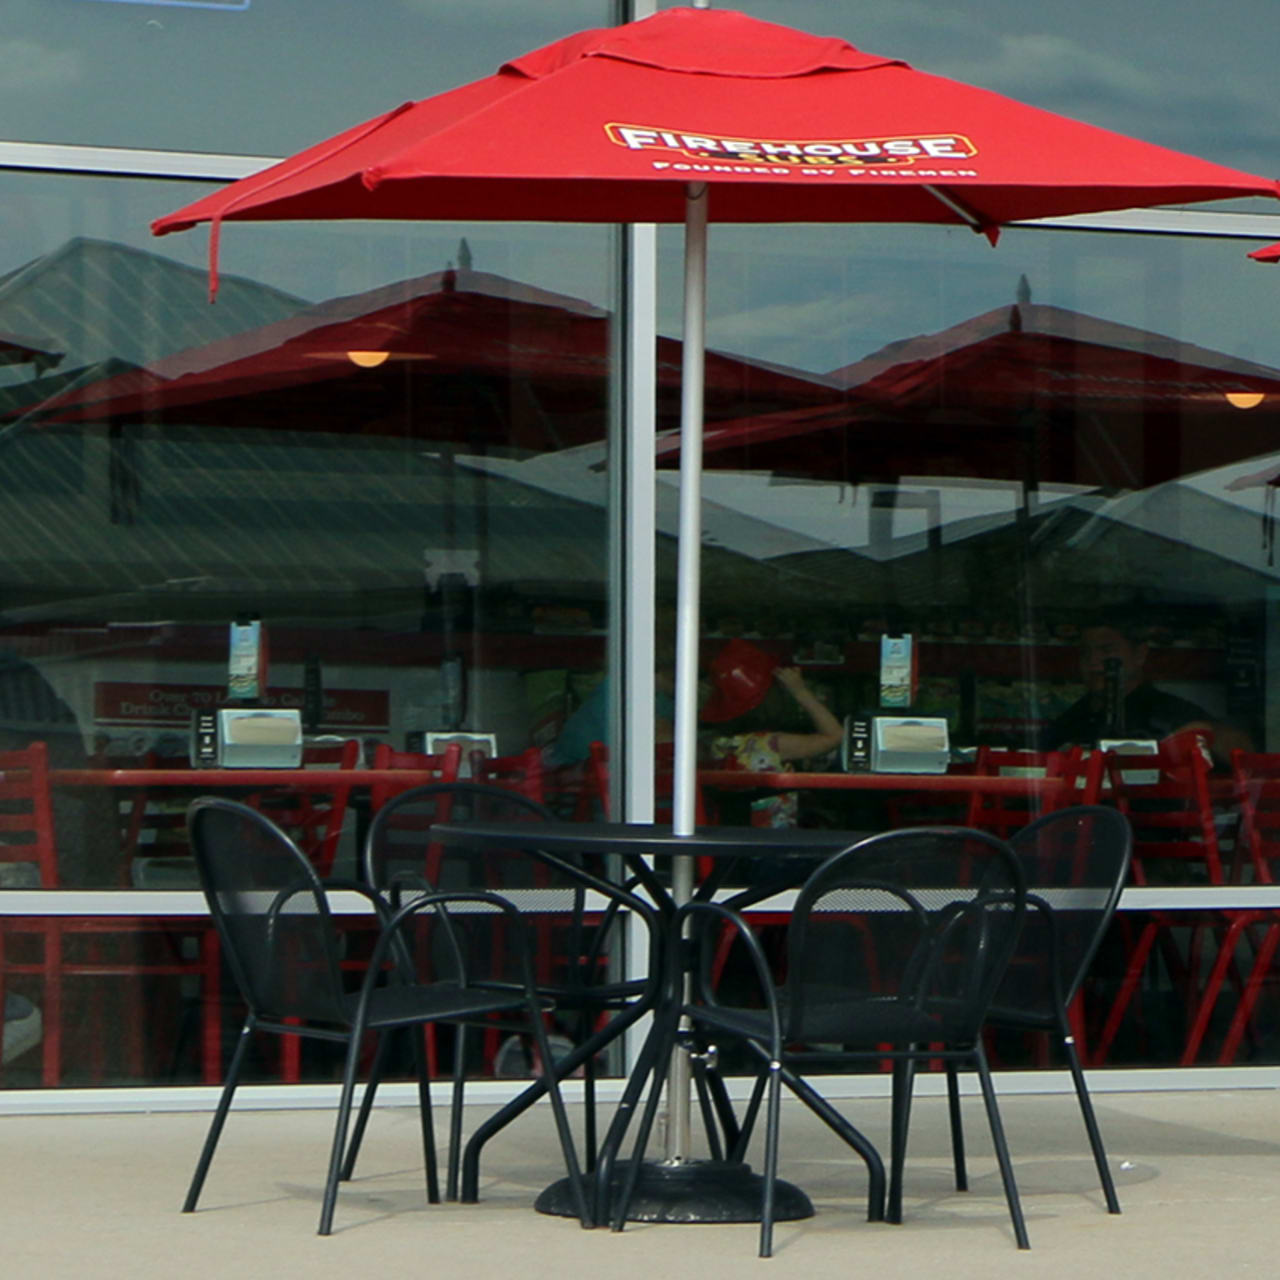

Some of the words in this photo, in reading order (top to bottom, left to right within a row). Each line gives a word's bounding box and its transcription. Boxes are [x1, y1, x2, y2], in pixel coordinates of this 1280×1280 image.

[618, 126, 970, 159] FIREHOUSE
[652, 161, 790, 175] FOUNDED
[801, 168, 835, 176] BY
[848, 168, 978, 177] FIREMEN
